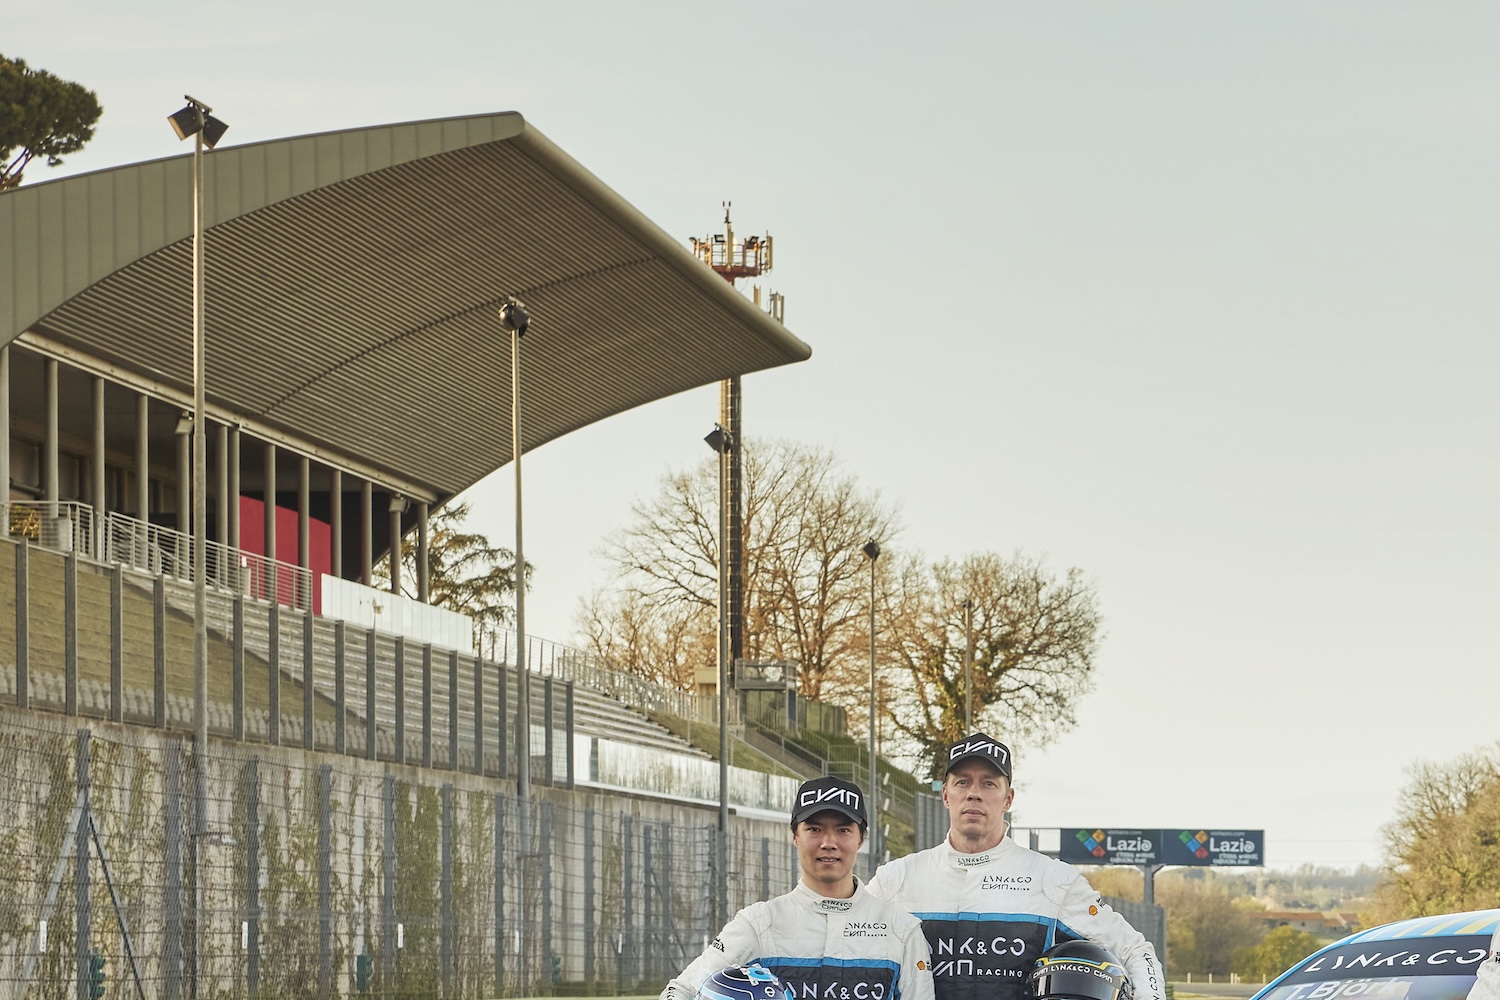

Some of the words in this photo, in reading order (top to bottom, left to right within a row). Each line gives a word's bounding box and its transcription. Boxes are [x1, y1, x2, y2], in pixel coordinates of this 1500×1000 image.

[1106, 836, 1152, 851] Lazio
[1209, 837, 1255, 853] Lazio
[976, 967, 1023, 979] RACING
